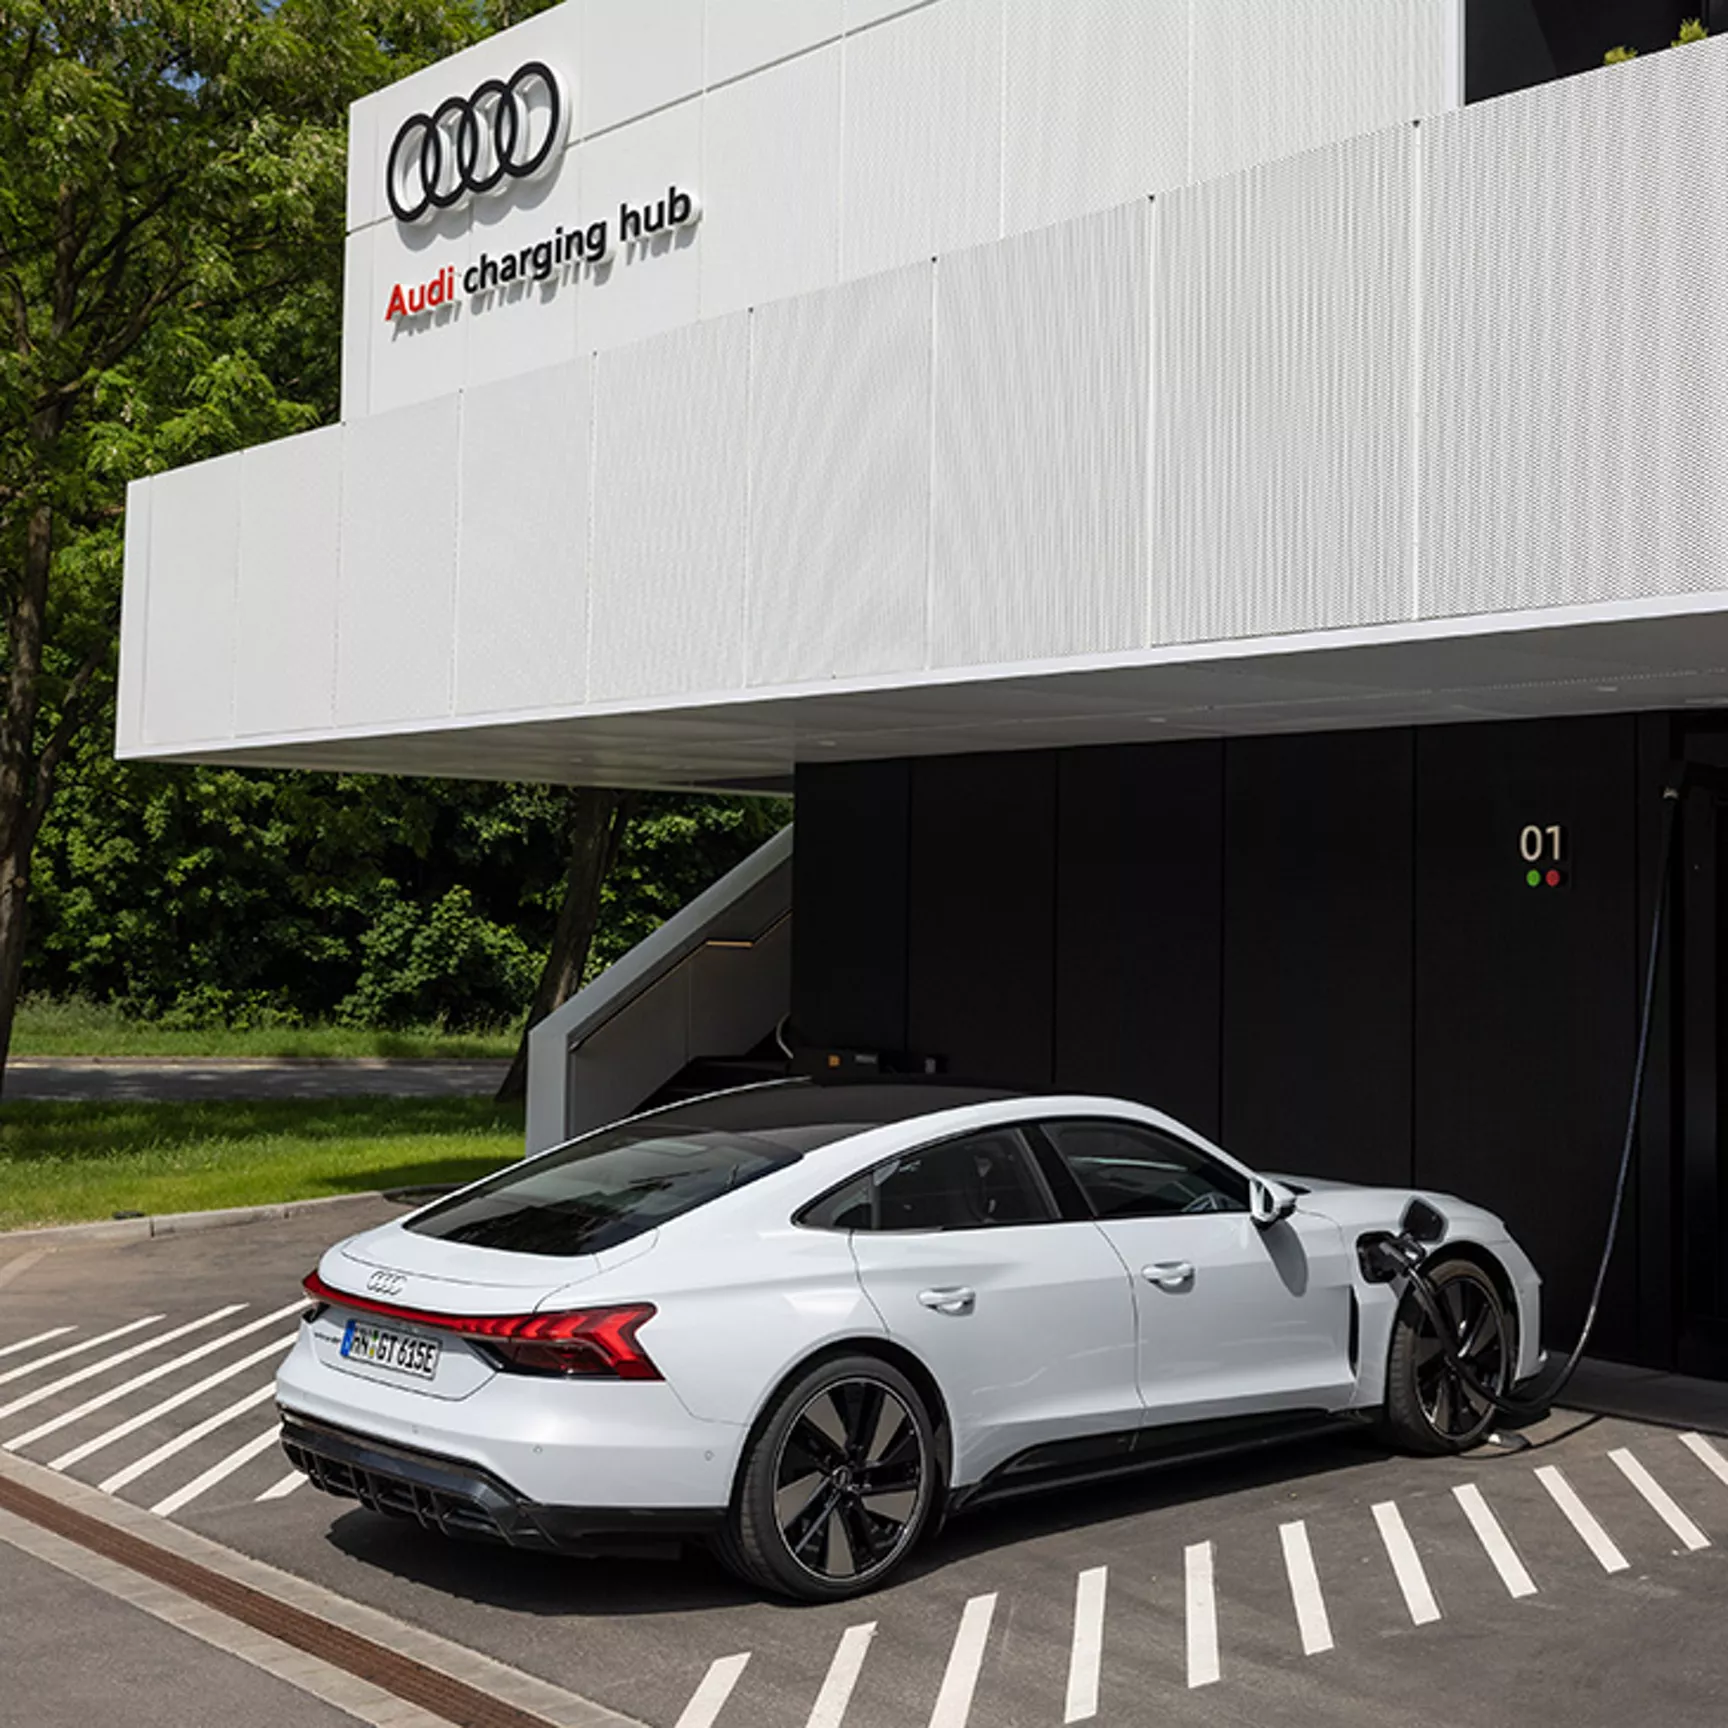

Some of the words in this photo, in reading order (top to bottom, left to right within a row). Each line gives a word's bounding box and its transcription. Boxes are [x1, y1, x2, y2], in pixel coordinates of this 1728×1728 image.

[385, 266, 455, 321] Audi
[463, 220, 608, 295] charging
[620, 186, 692, 241] hub
[1520, 824, 1561, 861] 01
[397, 1337, 437, 1373] 615E
